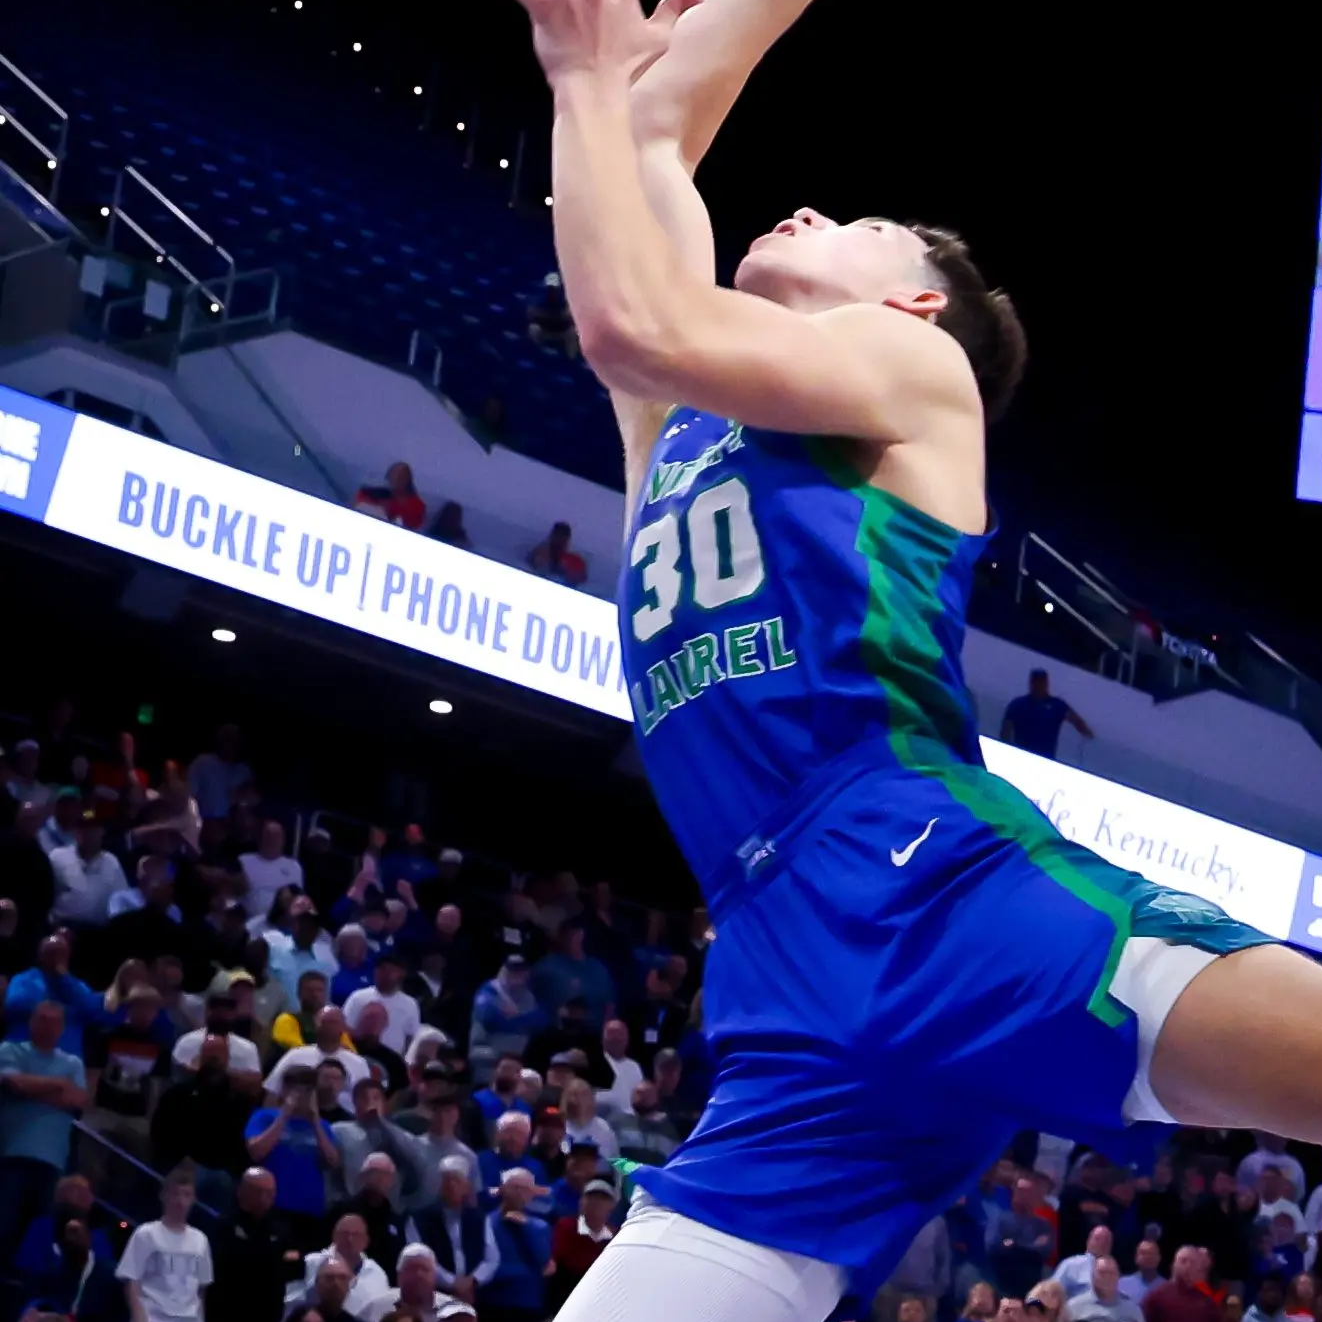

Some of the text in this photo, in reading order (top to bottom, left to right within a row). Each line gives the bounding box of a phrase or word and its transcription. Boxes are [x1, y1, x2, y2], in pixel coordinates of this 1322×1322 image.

[118, 470, 286, 576] BUCKLE
[296, 532, 352, 595] UP
[381, 563, 513, 654] PHONE
[630, 477, 765, 642] 30
[632, 616, 797, 736] LAUREL
[1094, 808, 1245, 900] Kentucky.
